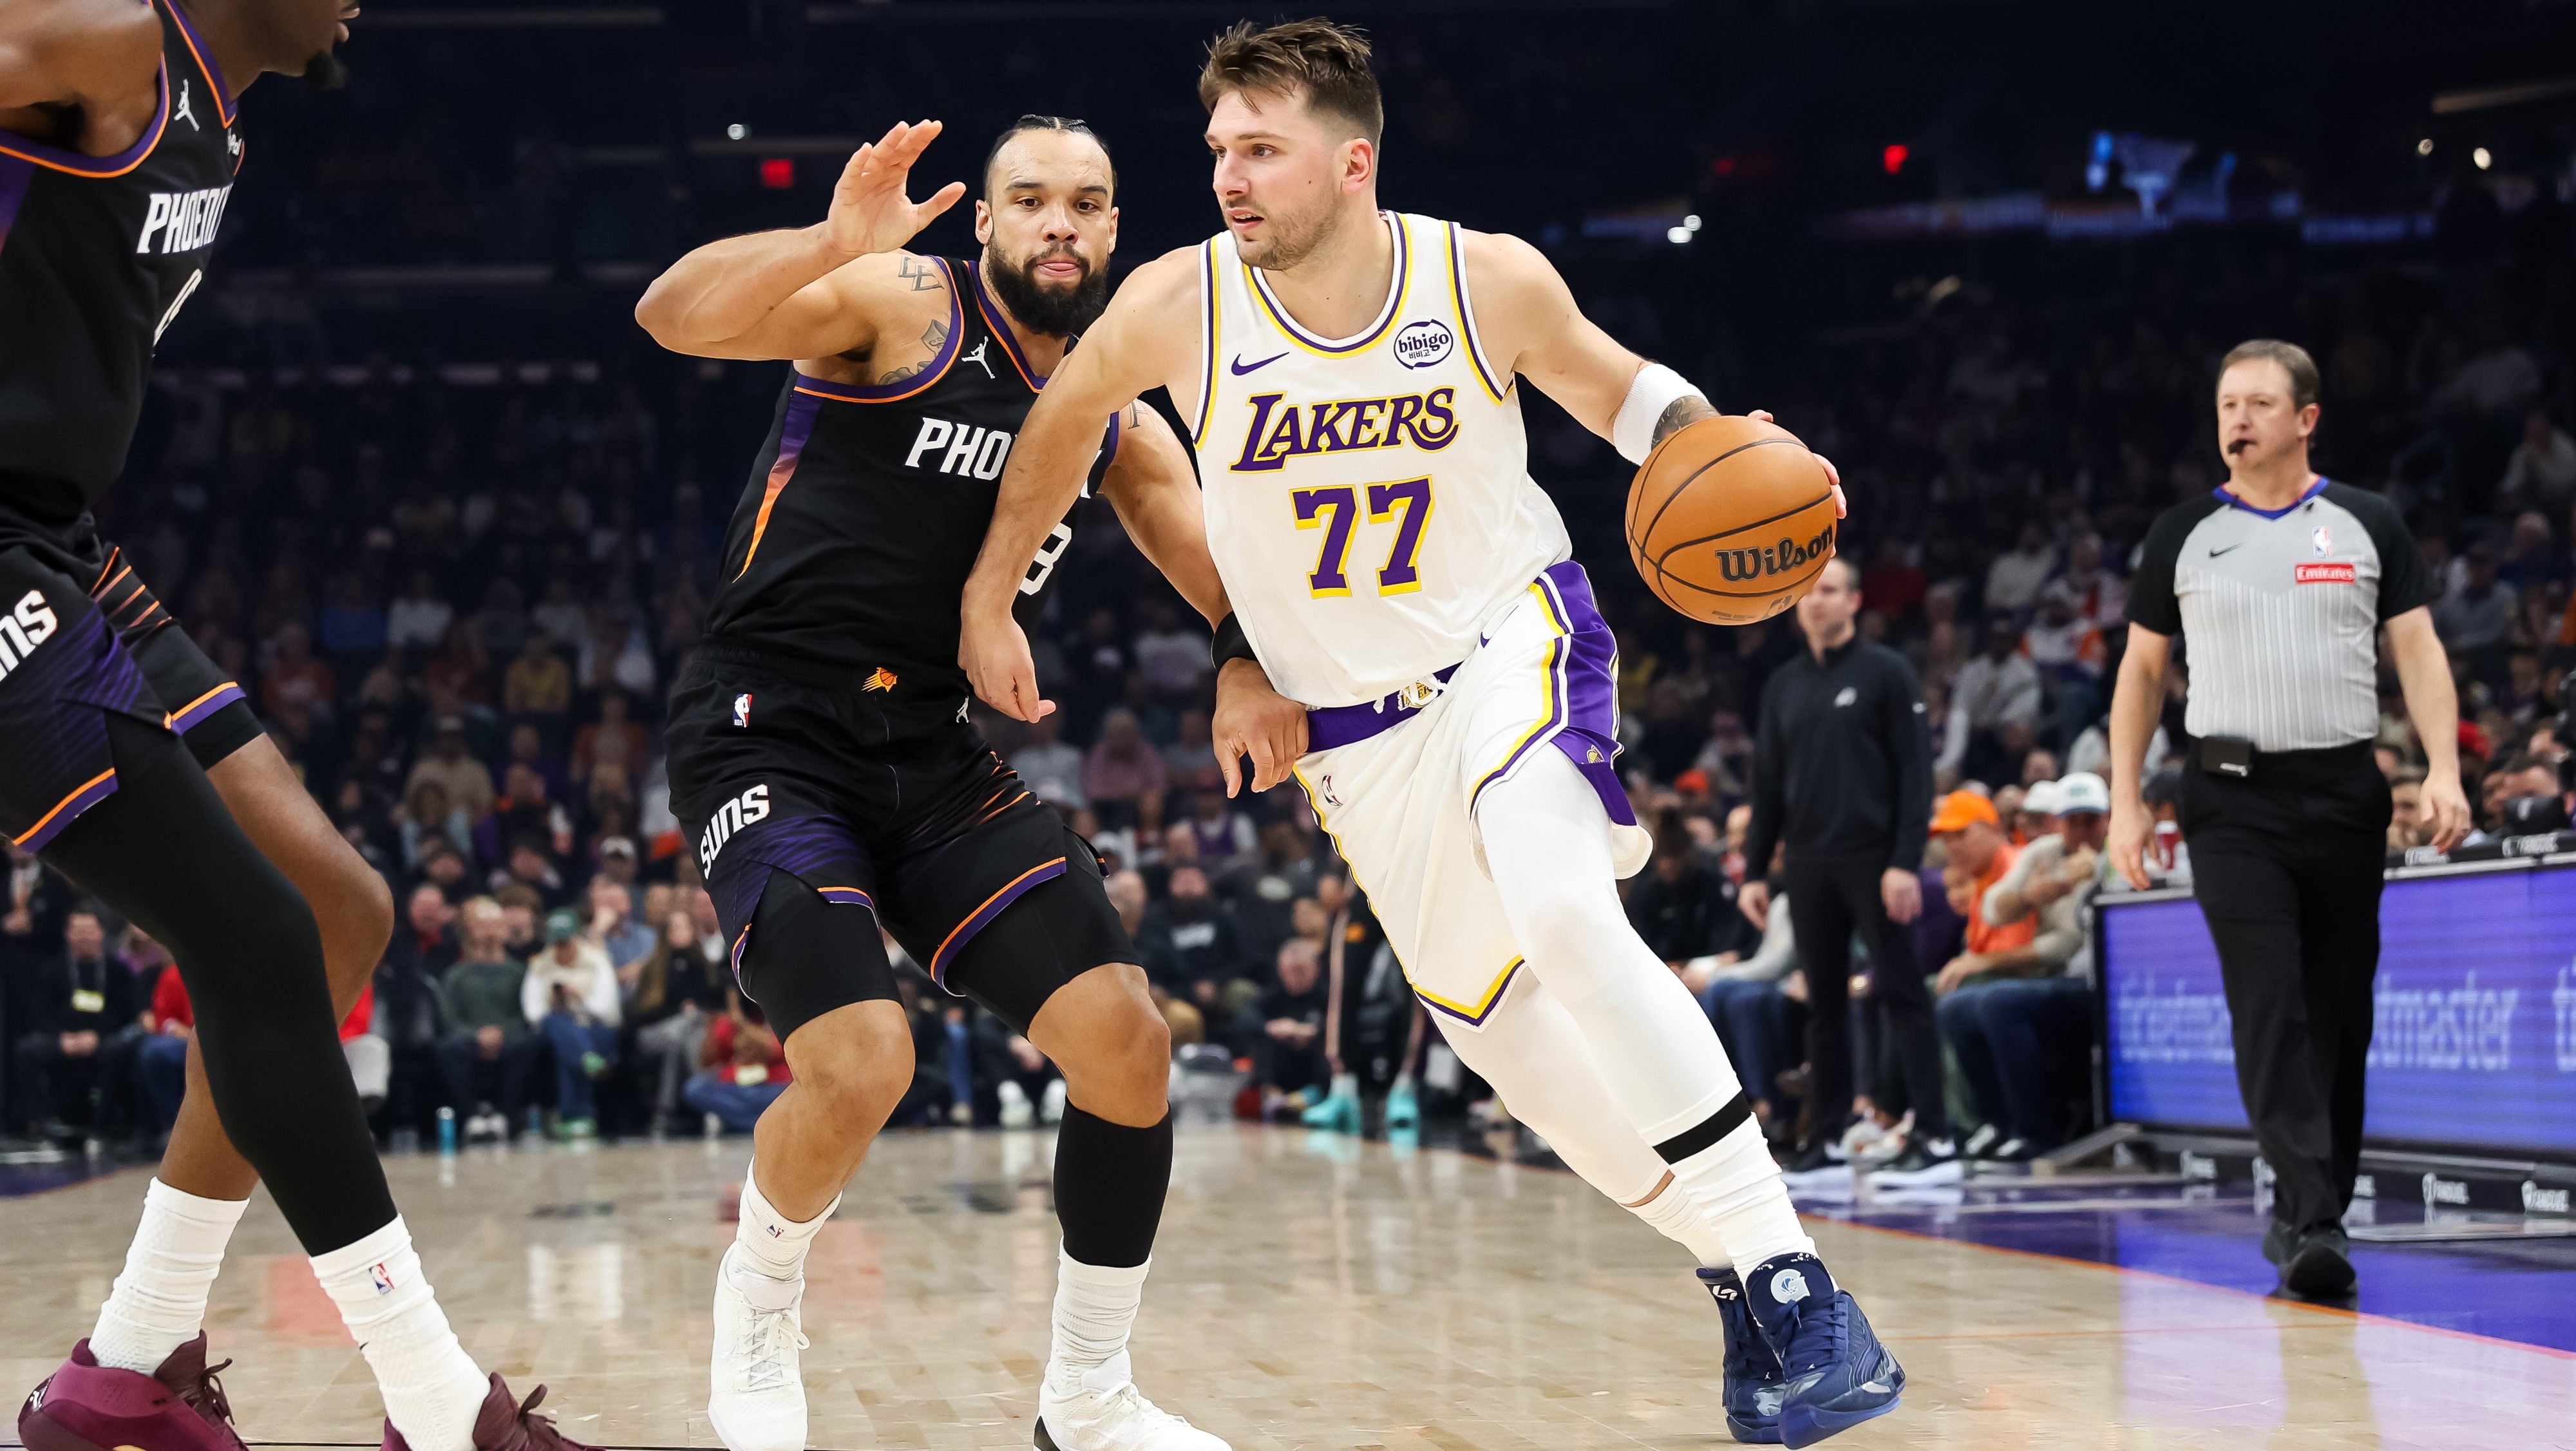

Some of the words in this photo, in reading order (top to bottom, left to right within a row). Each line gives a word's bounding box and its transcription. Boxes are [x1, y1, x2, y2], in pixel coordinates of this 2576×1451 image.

[1398, 333, 1449, 353] bibigo
[1408, 349, 1430, 359] 비비고
[905, 417, 1018, 480] PHO
[1228, 385, 1461, 473] LAKERS
[1289, 474, 1435, 599] 77
[1715, 523, 1833, 583] Wilson
[701, 784, 770, 880] SUNS
